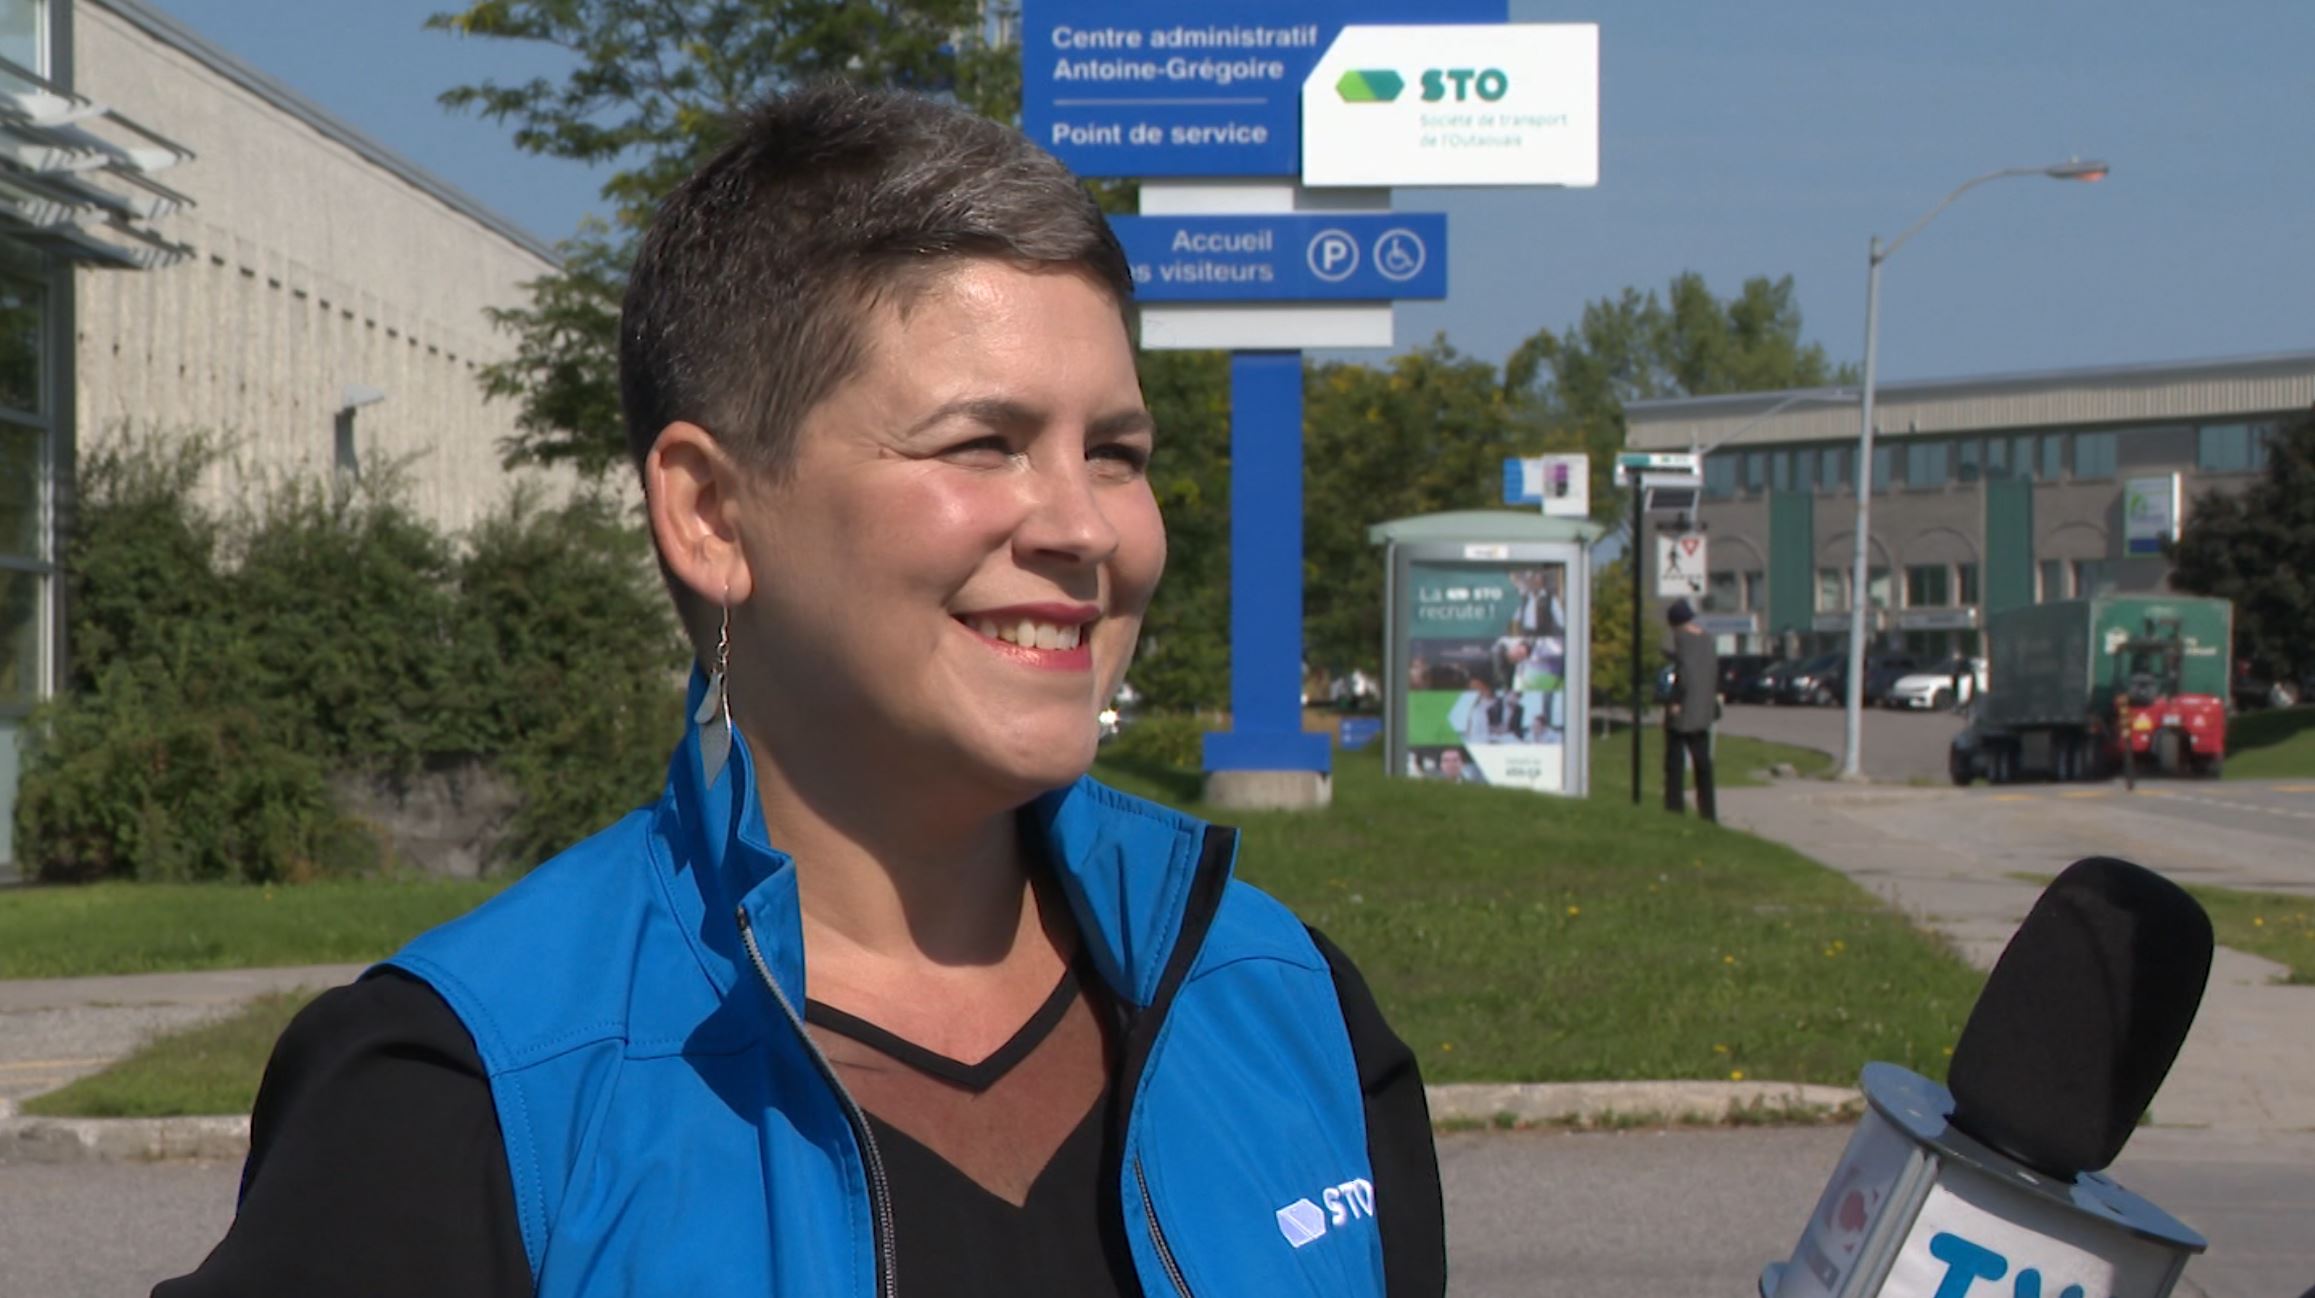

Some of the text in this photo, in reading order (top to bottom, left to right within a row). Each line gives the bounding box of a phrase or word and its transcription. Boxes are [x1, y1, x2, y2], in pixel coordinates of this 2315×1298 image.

[1051, 25, 1318, 49] Centre administratif
[1052, 57, 1285, 85] Antoine-Grégoire
[1420, 68, 1509, 102] STO
[1478, 113, 1495, 126] de
[1499, 113, 1568, 129] transport
[1052, 123, 1268, 145] Point de service
[1420, 133, 1438, 147] de
[1171, 229, 1274, 252] Accueil
[1322, 239, 1347, 269] P
[1158, 260, 1274, 282] visiteurs
[1418, 604, 1485, 620] recrute
